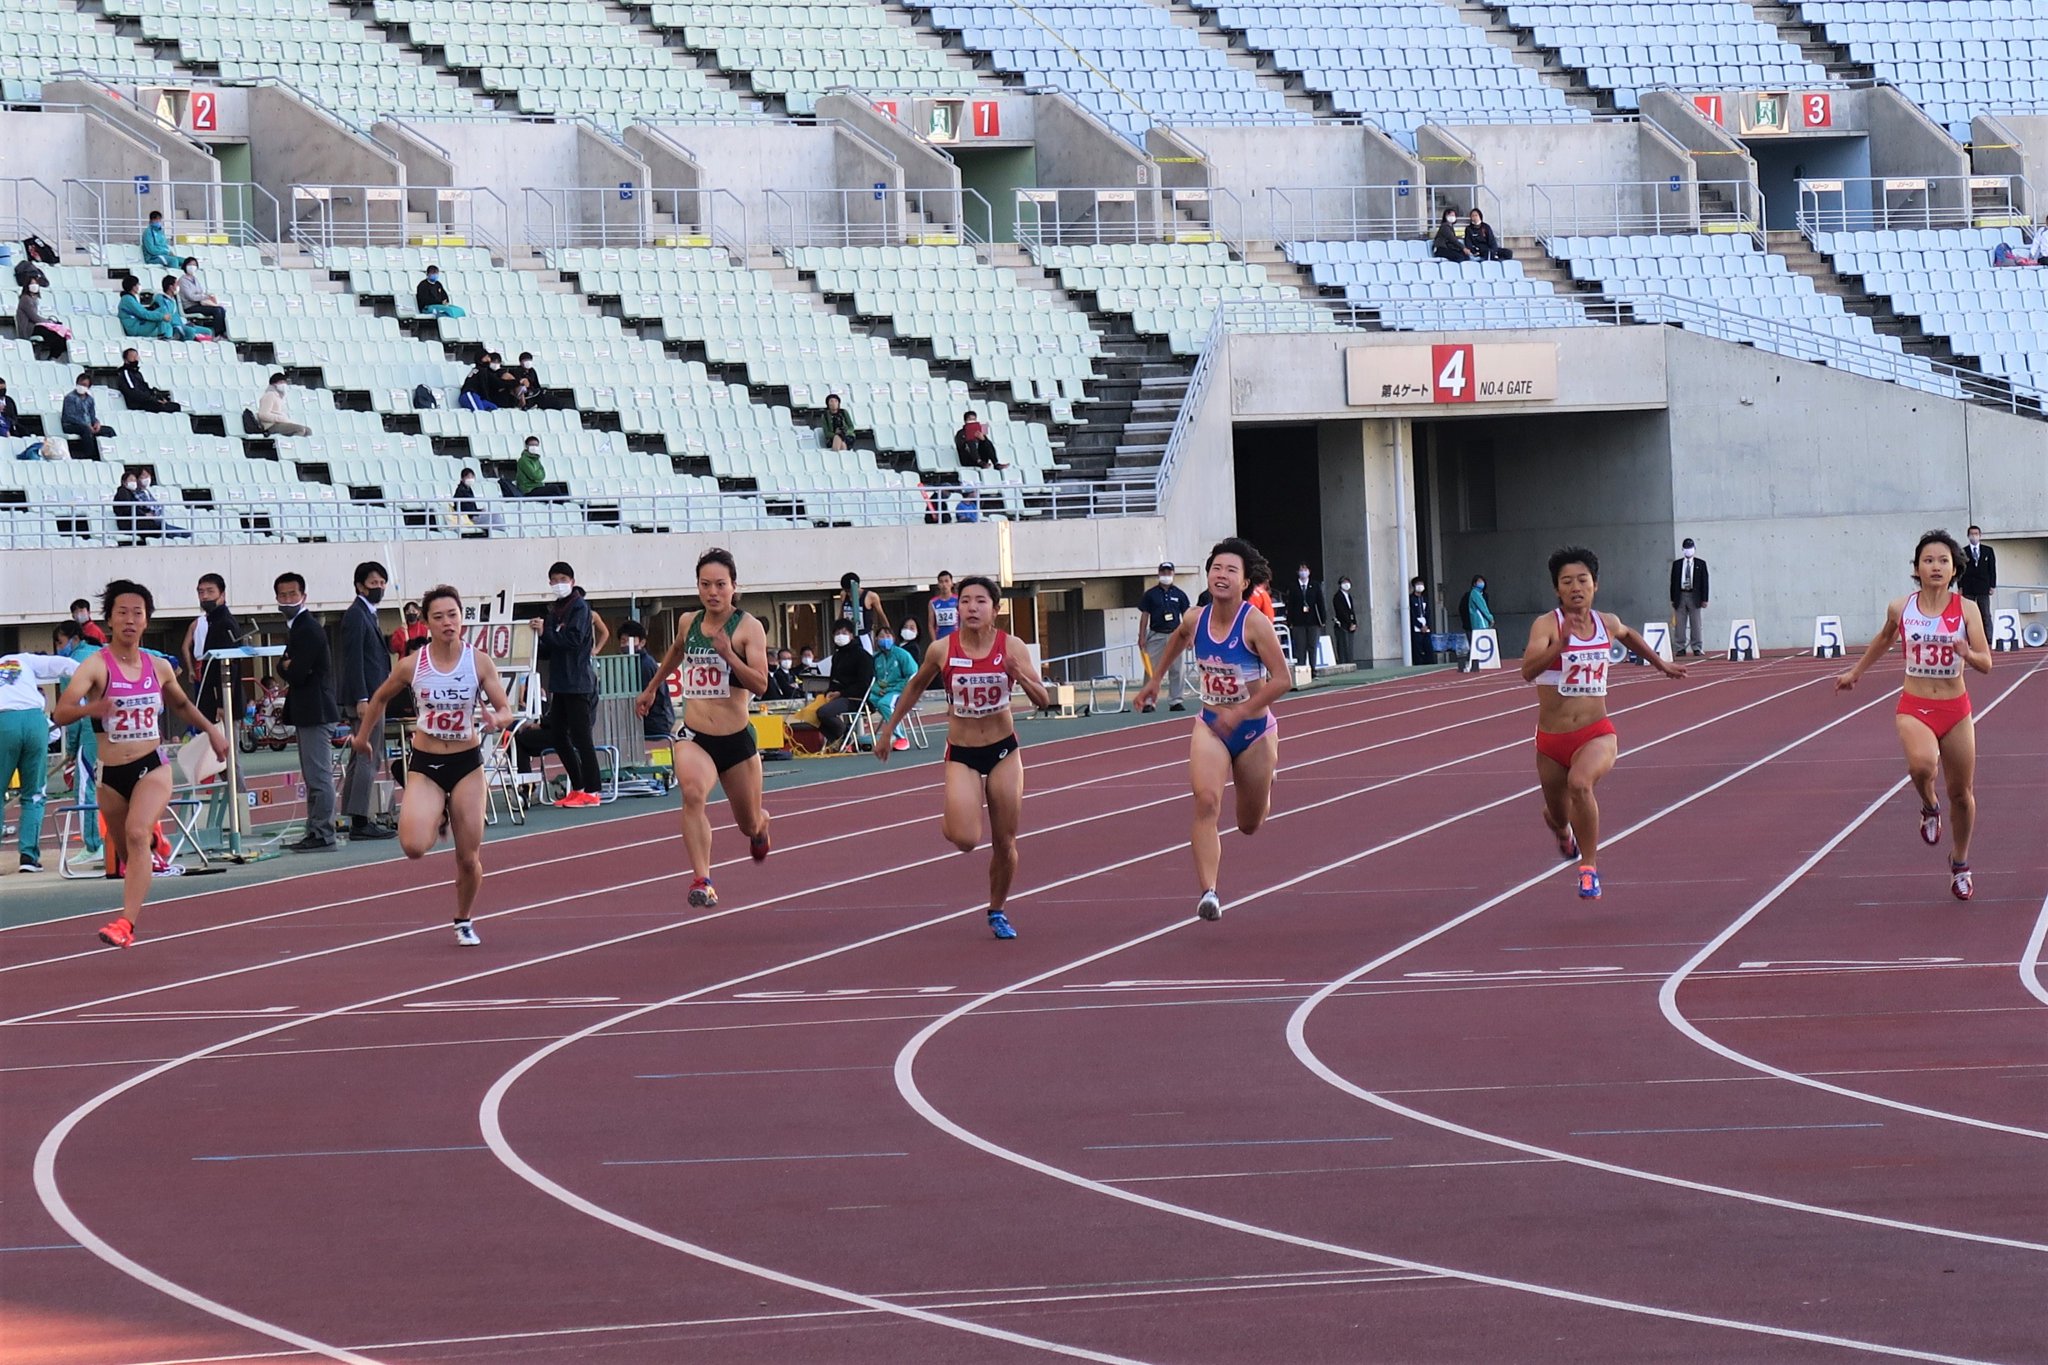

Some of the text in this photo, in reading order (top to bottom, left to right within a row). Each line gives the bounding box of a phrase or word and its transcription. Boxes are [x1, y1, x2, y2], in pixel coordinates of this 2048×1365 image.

[197, 95, 211, 127] 2
[980, 103, 990, 134] 1
[1808, 96, 1824, 123] 3
[1438, 350, 1466, 397] 4
[1381, 383, 1428, 398] 第4ゲート
[1480, 380, 1533, 396] NO.4 GATE
[496, 590, 506, 614] 1
[938, 612, 954, 622] 324
[1904, 618, 1931, 627] DENSO
[1735, 625, 1752, 653] 6
[1820, 622, 1837, 649] 5
[1923, 634, 1954, 643] 住友電工
[1998, 615, 2016, 642] 3
[1475, 635, 1494, 663] 9
[1647, 629, 1665, 653] 7
[694, 656, 719, 665] 住友電工
[1579, 652, 1608, 661] 住友電工
[1912, 644, 1954, 666] 138
[688, 666, 722, 687] 130
[969, 676, 1002, 685] 住友電工
[1566, 662, 1604, 684] 214
[434, 688, 470, 700] いちご
[1204, 673, 1238, 695] 143
[126, 696, 155, 707] 住友電工
[436, 703, 467, 711] 住友電工
[959, 686, 1002, 708] 159
[115, 707, 155, 731] 218
[425, 710, 465, 731] 162
[248, 791, 256, 805] 6
[262, 790, 270, 804] 8
